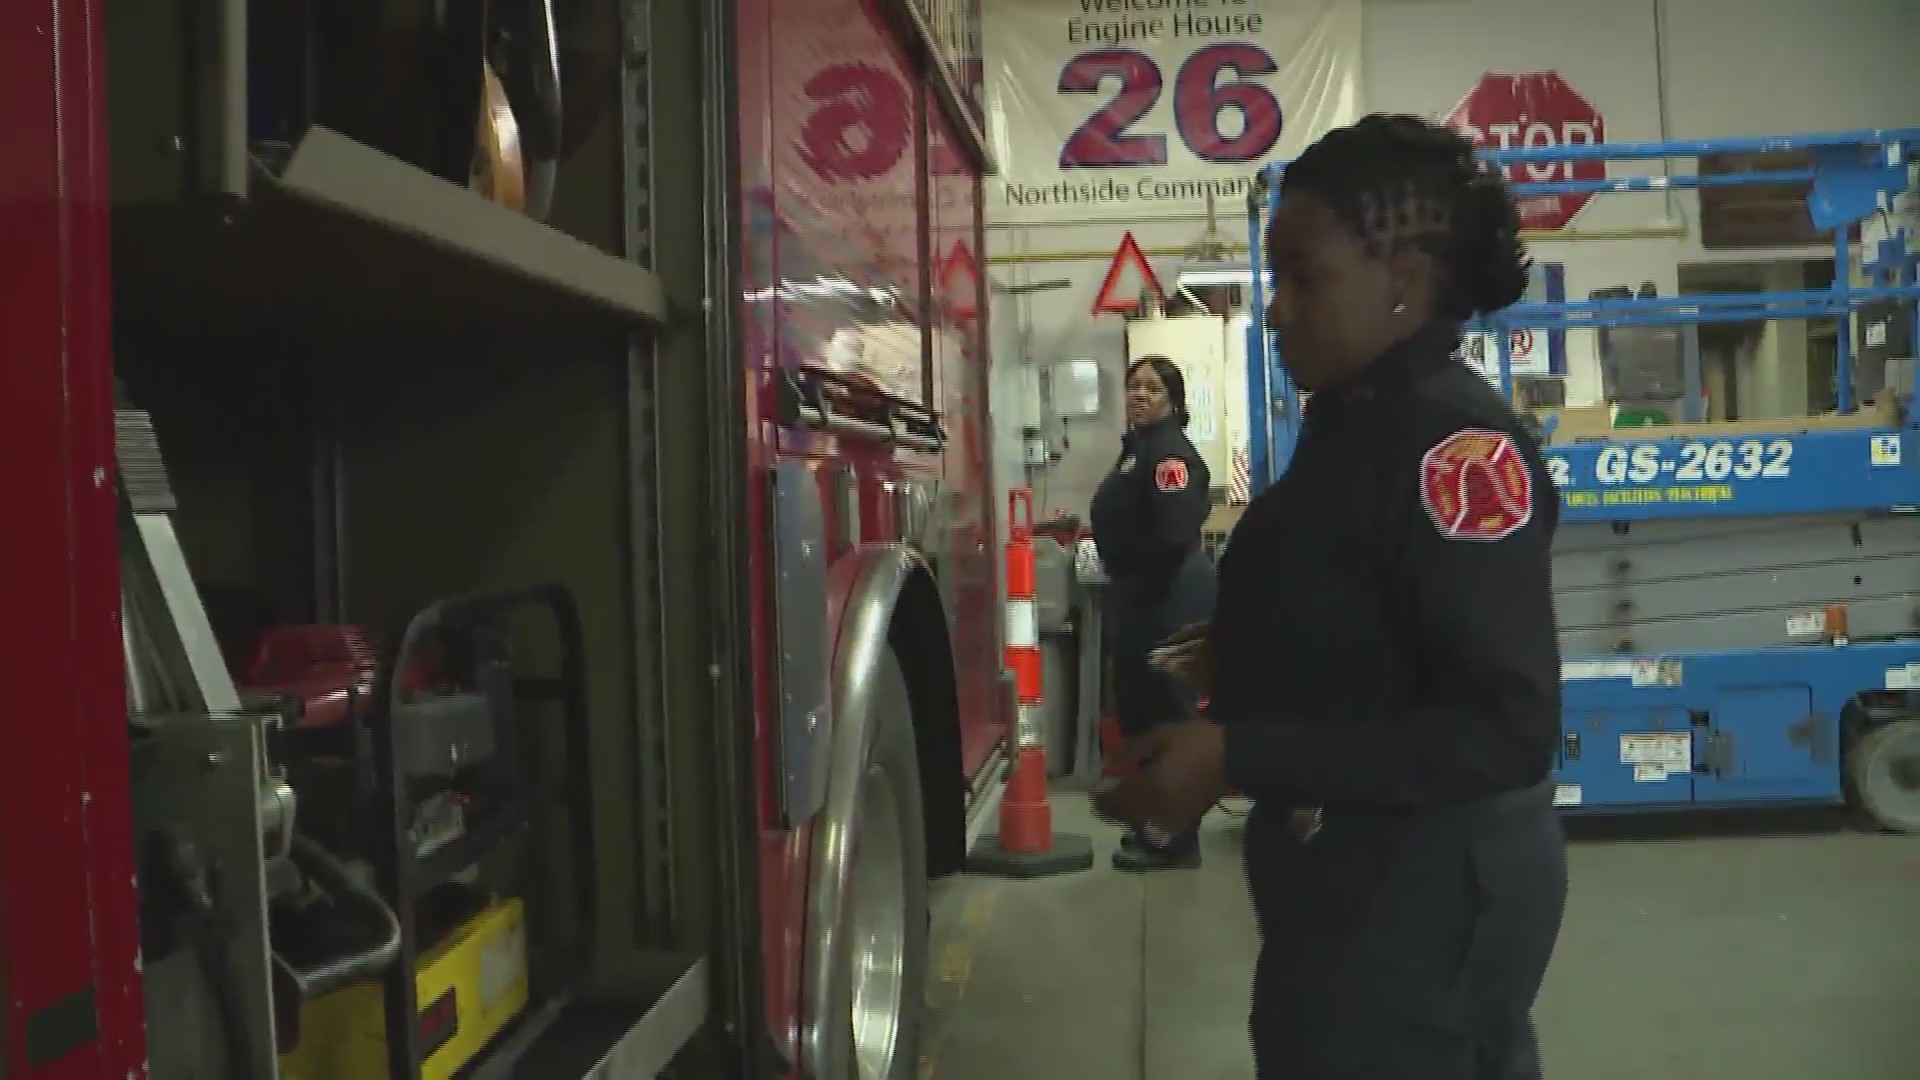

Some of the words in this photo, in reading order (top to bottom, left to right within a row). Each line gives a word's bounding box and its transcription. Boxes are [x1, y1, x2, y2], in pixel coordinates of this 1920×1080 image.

[1068, 16, 1164, 44] Engine
[1174, 11, 1263, 37] House
[1057, 41, 1283, 169] 26
[1006, 177, 1130, 205] Northside
[1137, 175, 1252, 201] Comman
[1595, 439, 1793, 484] GS-2632
